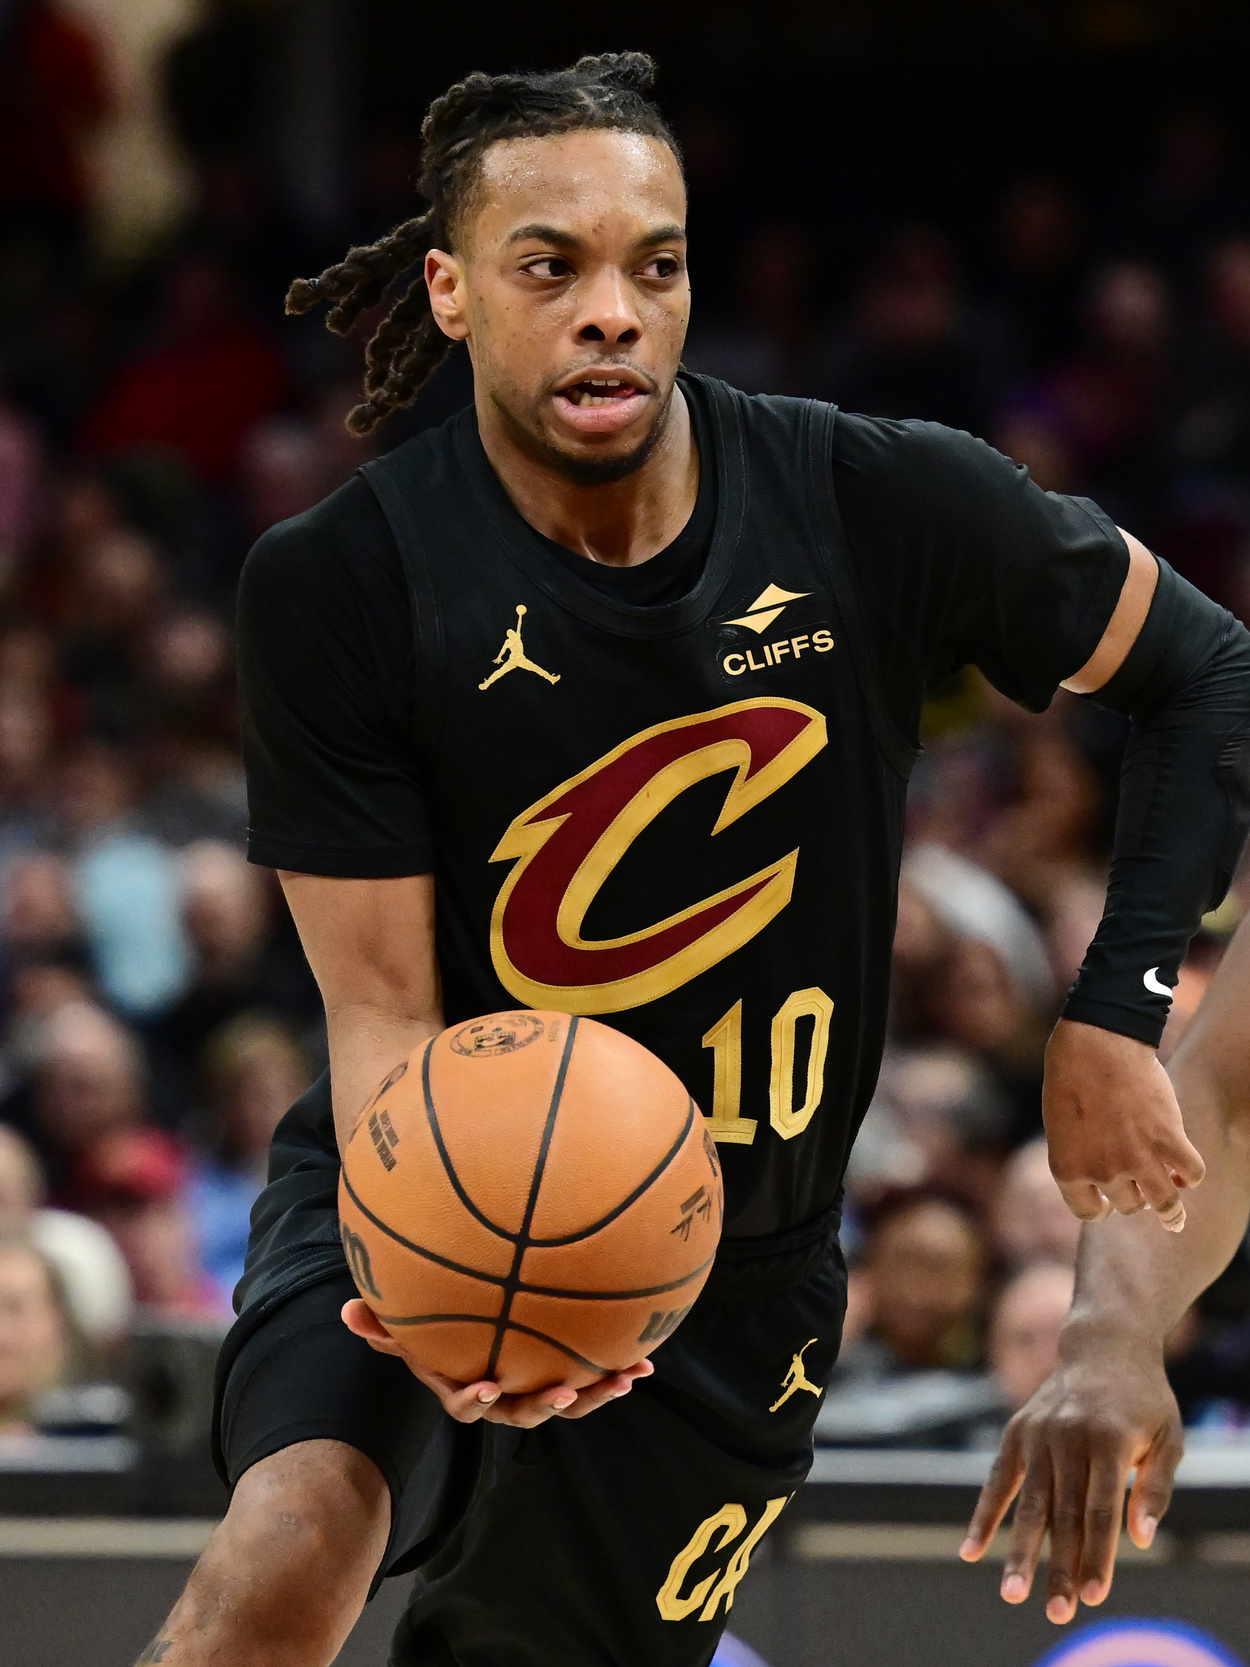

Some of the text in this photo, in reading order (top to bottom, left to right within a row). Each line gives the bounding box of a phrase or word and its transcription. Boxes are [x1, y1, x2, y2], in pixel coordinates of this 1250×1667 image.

[722, 629, 835, 677] CLIFFS
[488, 696, 829, 1016] C
[702, 986, 835, 1145] 10
[655, 1490, 797, 1623] CA
